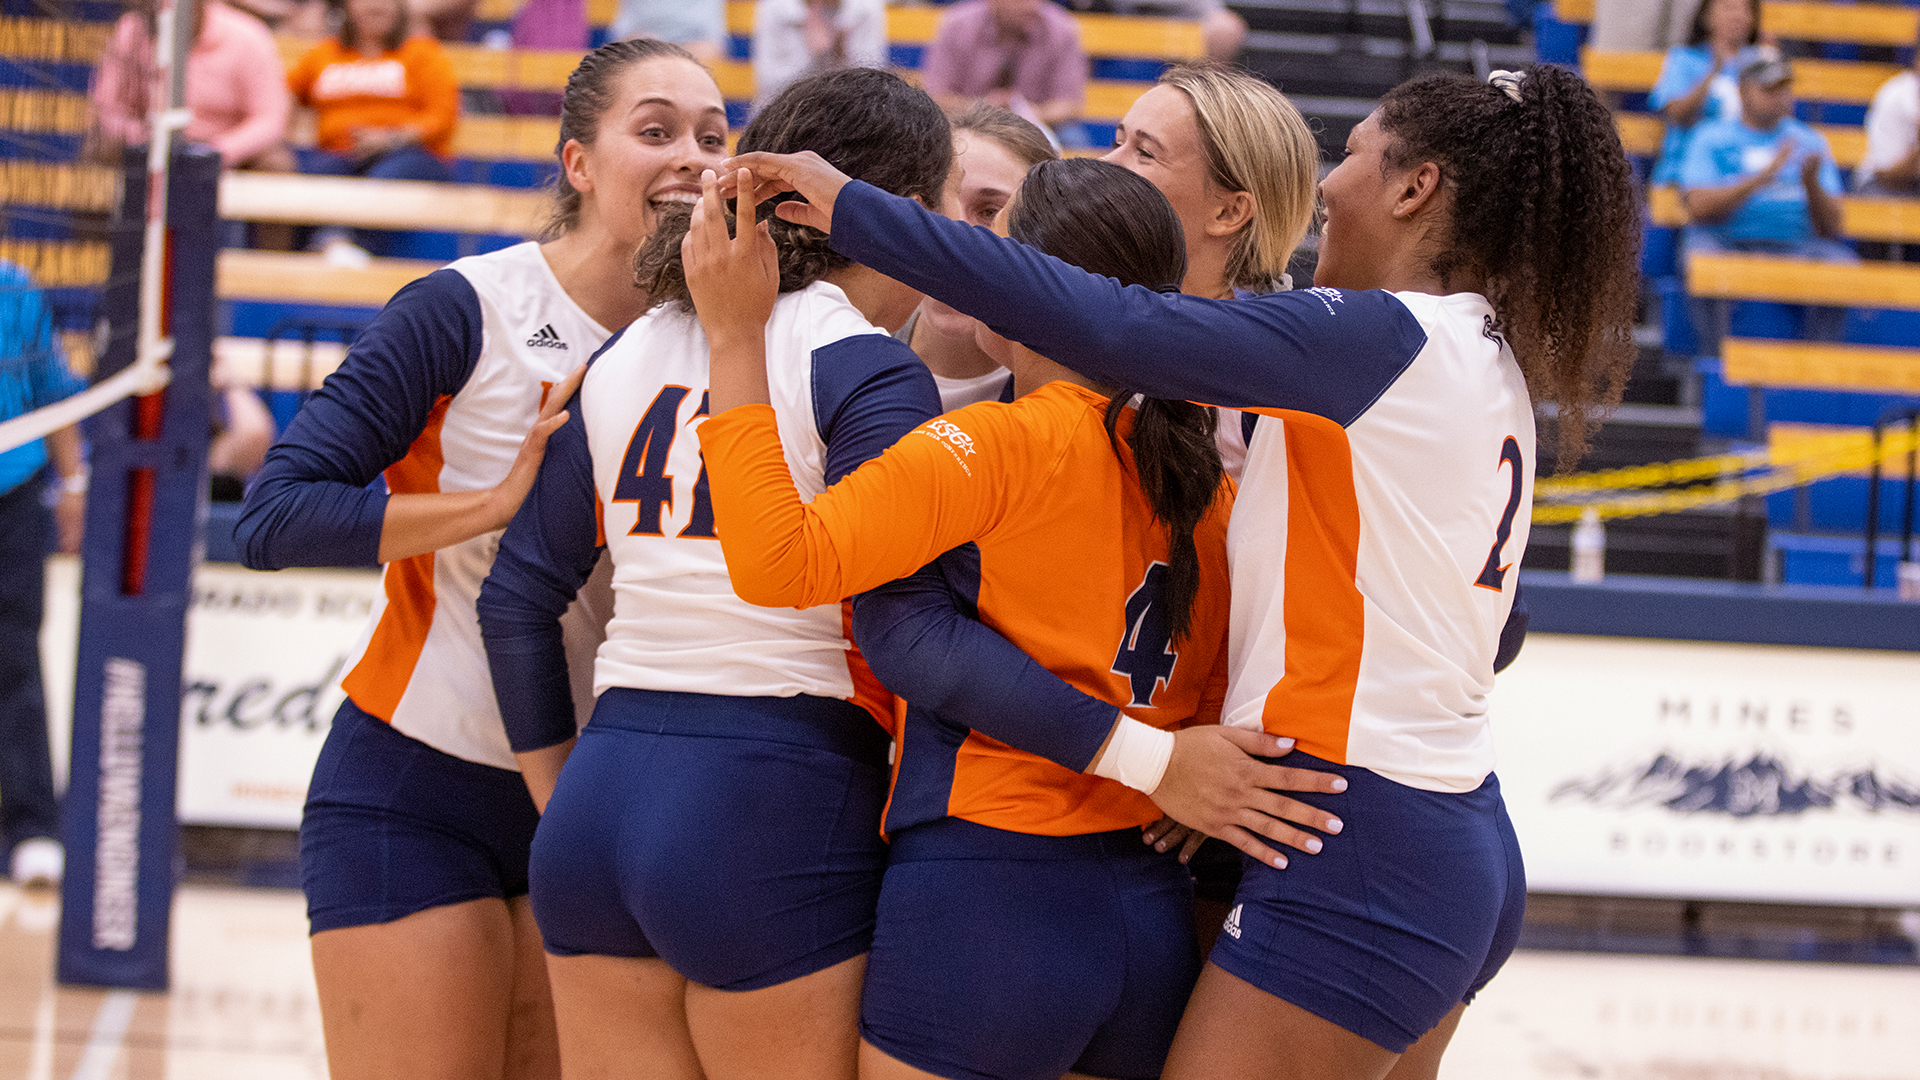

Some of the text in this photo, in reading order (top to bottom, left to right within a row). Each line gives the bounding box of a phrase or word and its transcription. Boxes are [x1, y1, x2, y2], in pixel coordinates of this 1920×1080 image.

[526, 337, 569, 350] adidas
[1473, 434, 1524, 593] 2
[1110, 560, 1179, 708] 4
[1658, 699, 1854, 734] MINES
[1610, 831, 1899, 864] BOOKSTORE
